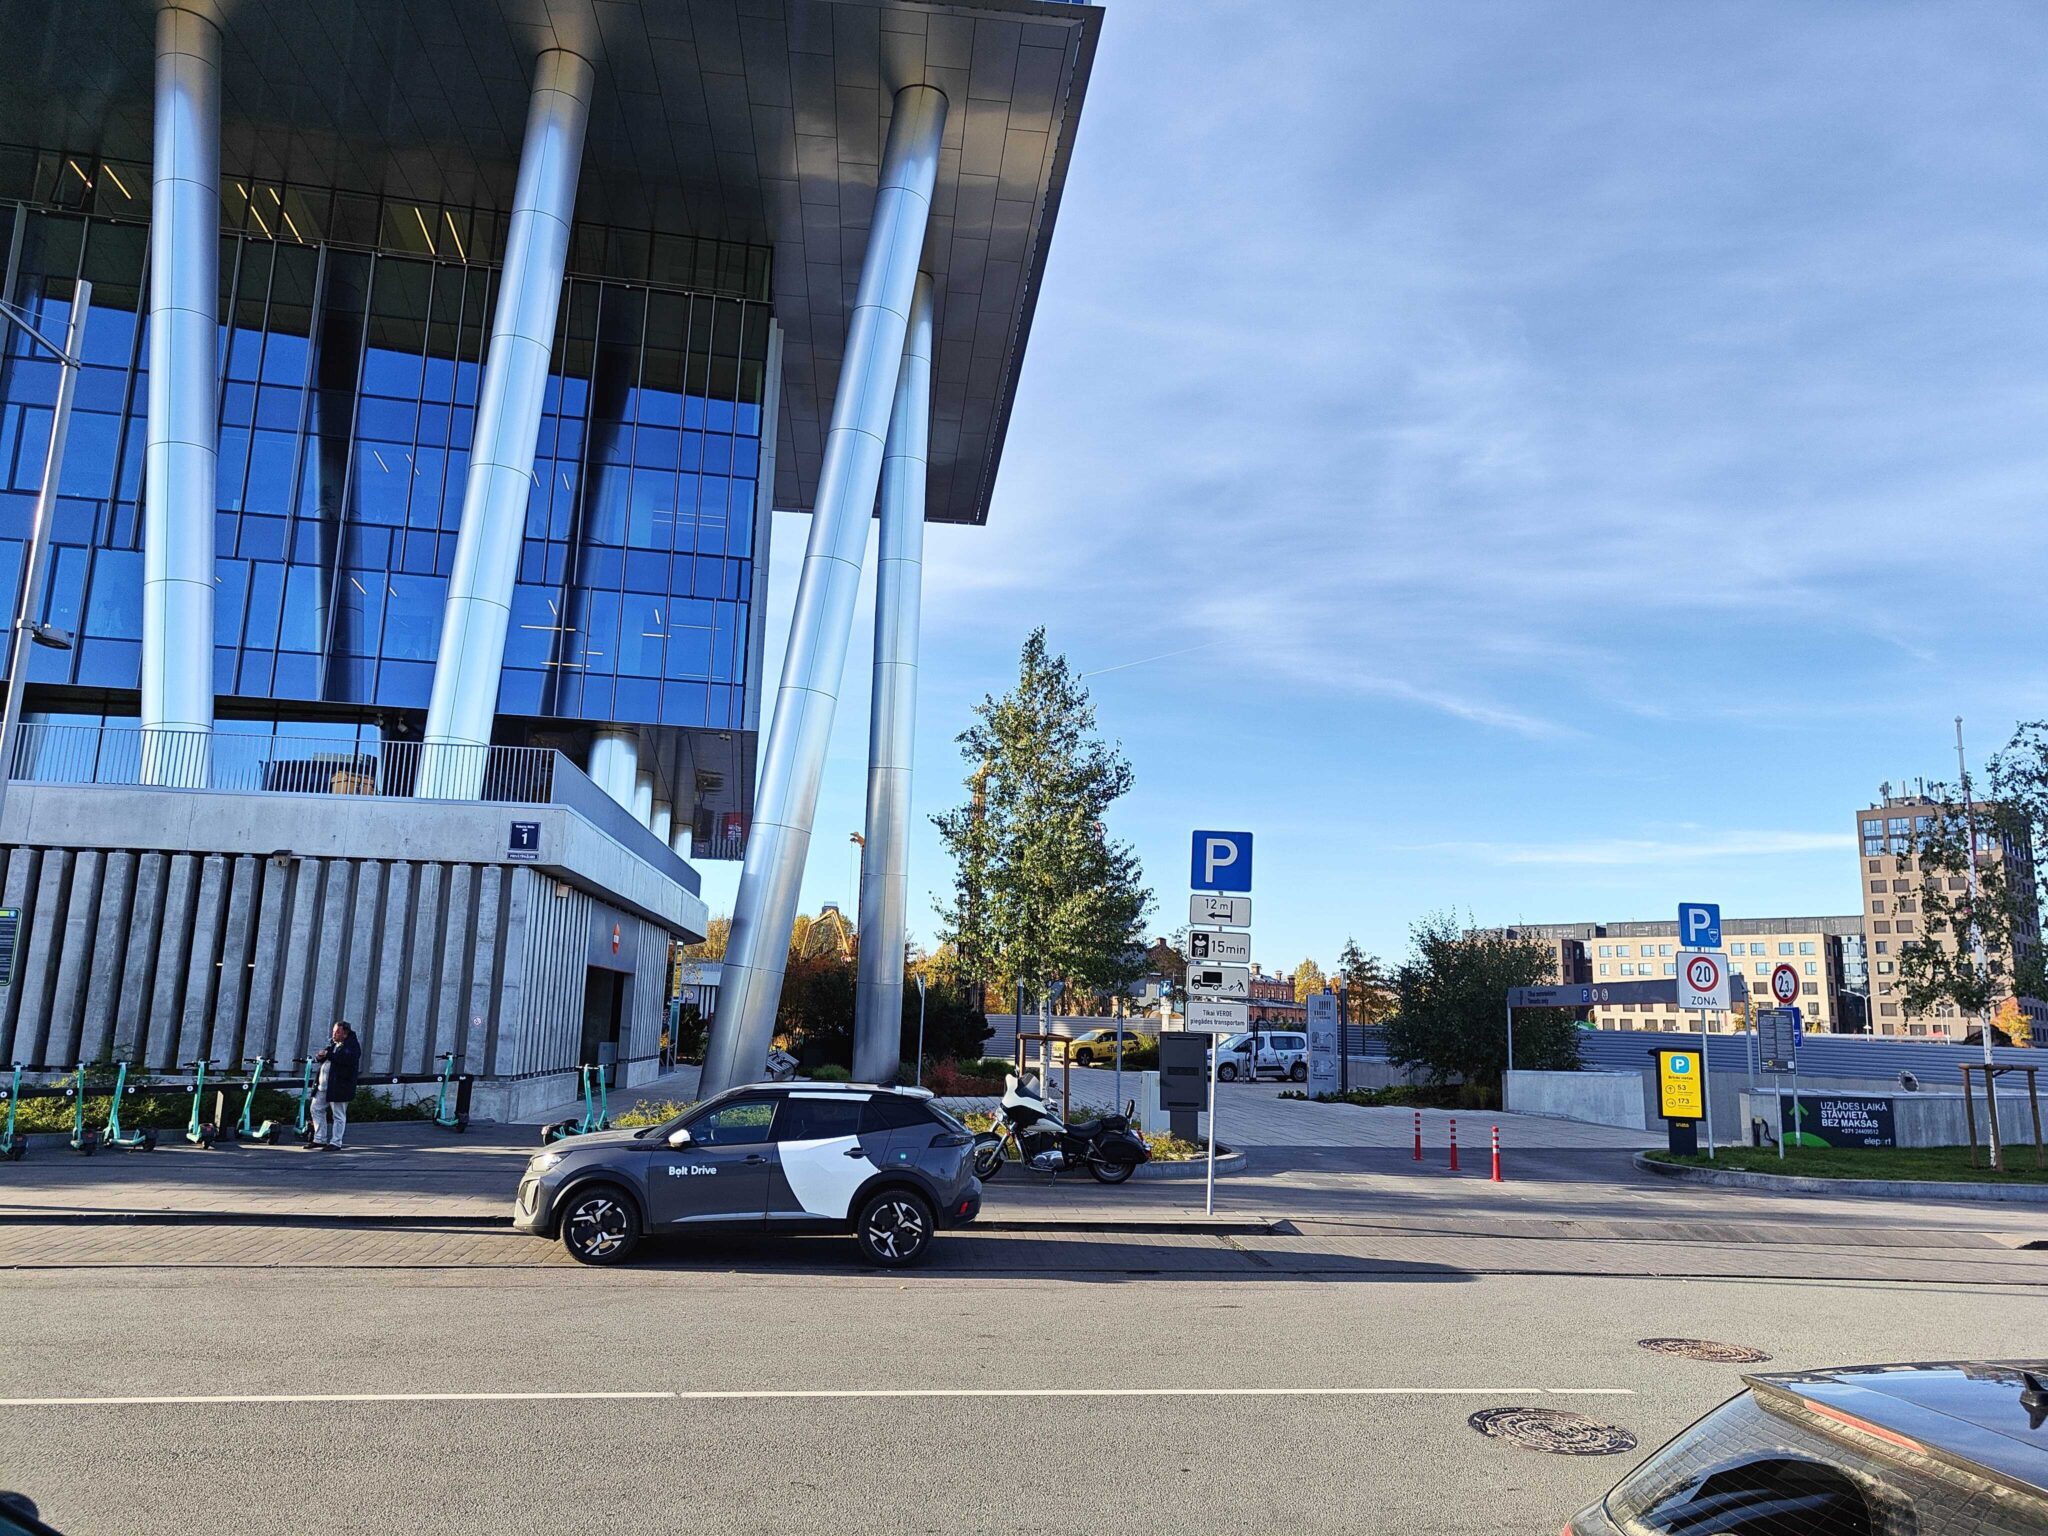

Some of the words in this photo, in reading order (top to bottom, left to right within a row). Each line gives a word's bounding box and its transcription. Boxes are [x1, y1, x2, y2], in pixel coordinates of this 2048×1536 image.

[521, 832, 528, 845] 1
[1205, 838, 1238, 883] P
[1205, 898, 1217, 910] 12
[1689, 908, 1711, 942] P
[1695, 965, 1711, 983] 20
[1691, 995, 1718, 1006] ZONA
[1675, 1058, 1685, 1071] P
[1820, 1100, 1860, 1111] UZLĀDES
[1861, 1101, 1888, 1112] LAIKĀ
[1821, 1109, 1869, 1119] STĀVVIETA
[1821, 1118, 1840, 1127] BEZ
[1841, 1119, 1879, 1128] MAKSAS
[1863, 1137, 1892, 1147] eleprt
[668, 1165, 688, 1178] Bolt
[690, 1164, 717, 1175] Drive
